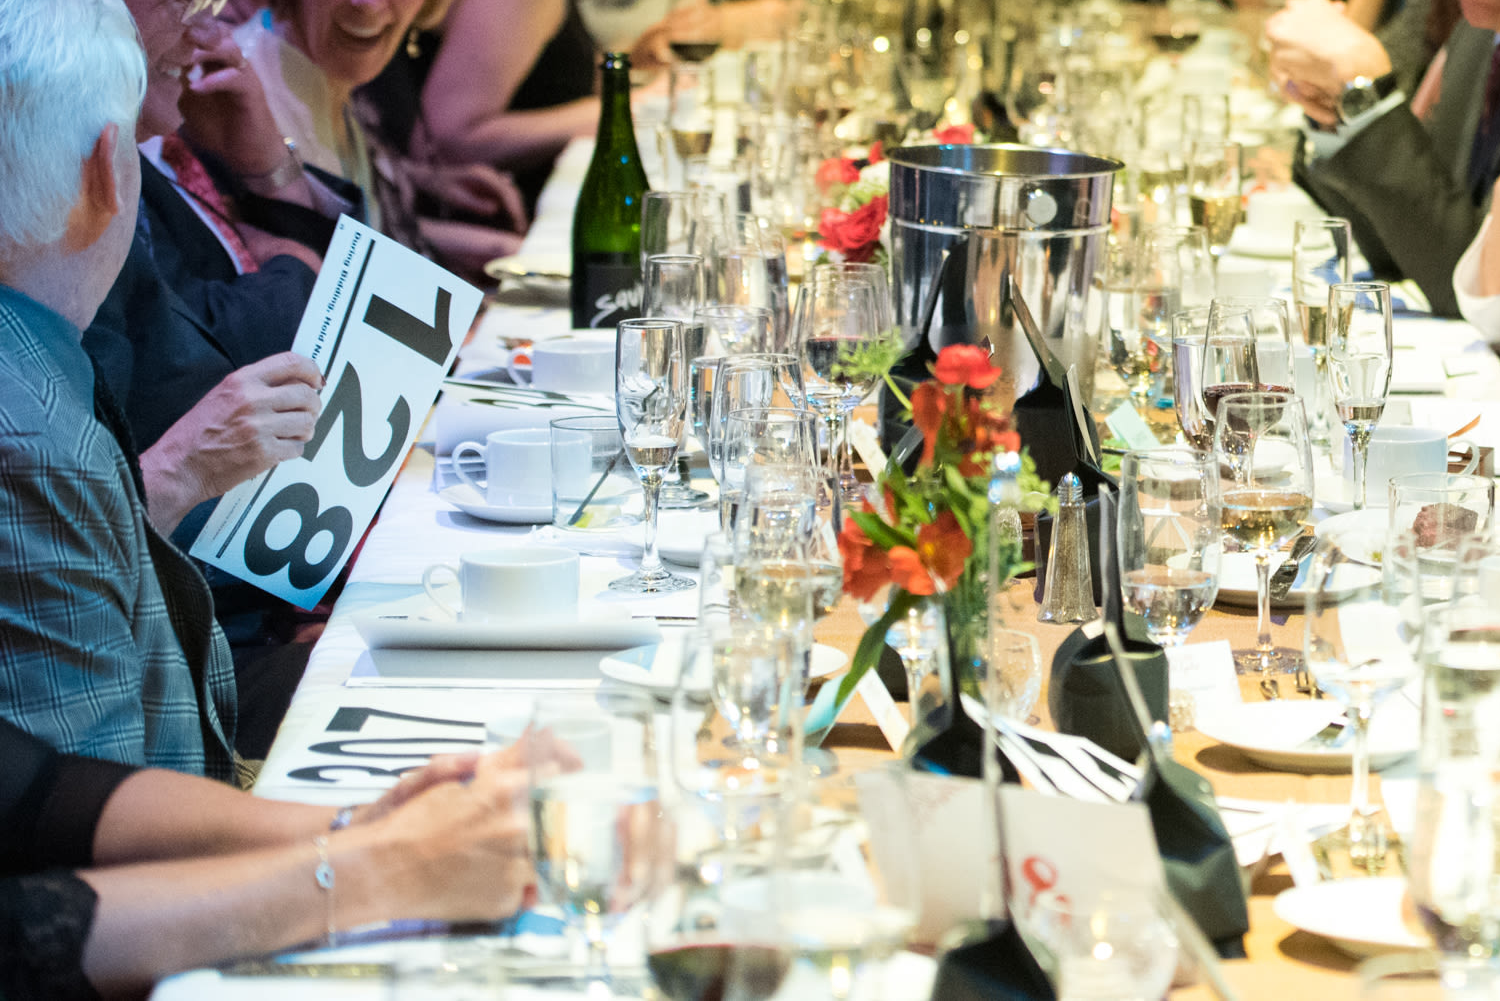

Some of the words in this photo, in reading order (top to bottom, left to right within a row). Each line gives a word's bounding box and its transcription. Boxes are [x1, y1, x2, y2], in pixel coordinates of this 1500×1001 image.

[343, 231, 362, 267] During
[317, 316, 332, 342] Hold
[244, 286, 453, 590] 128
